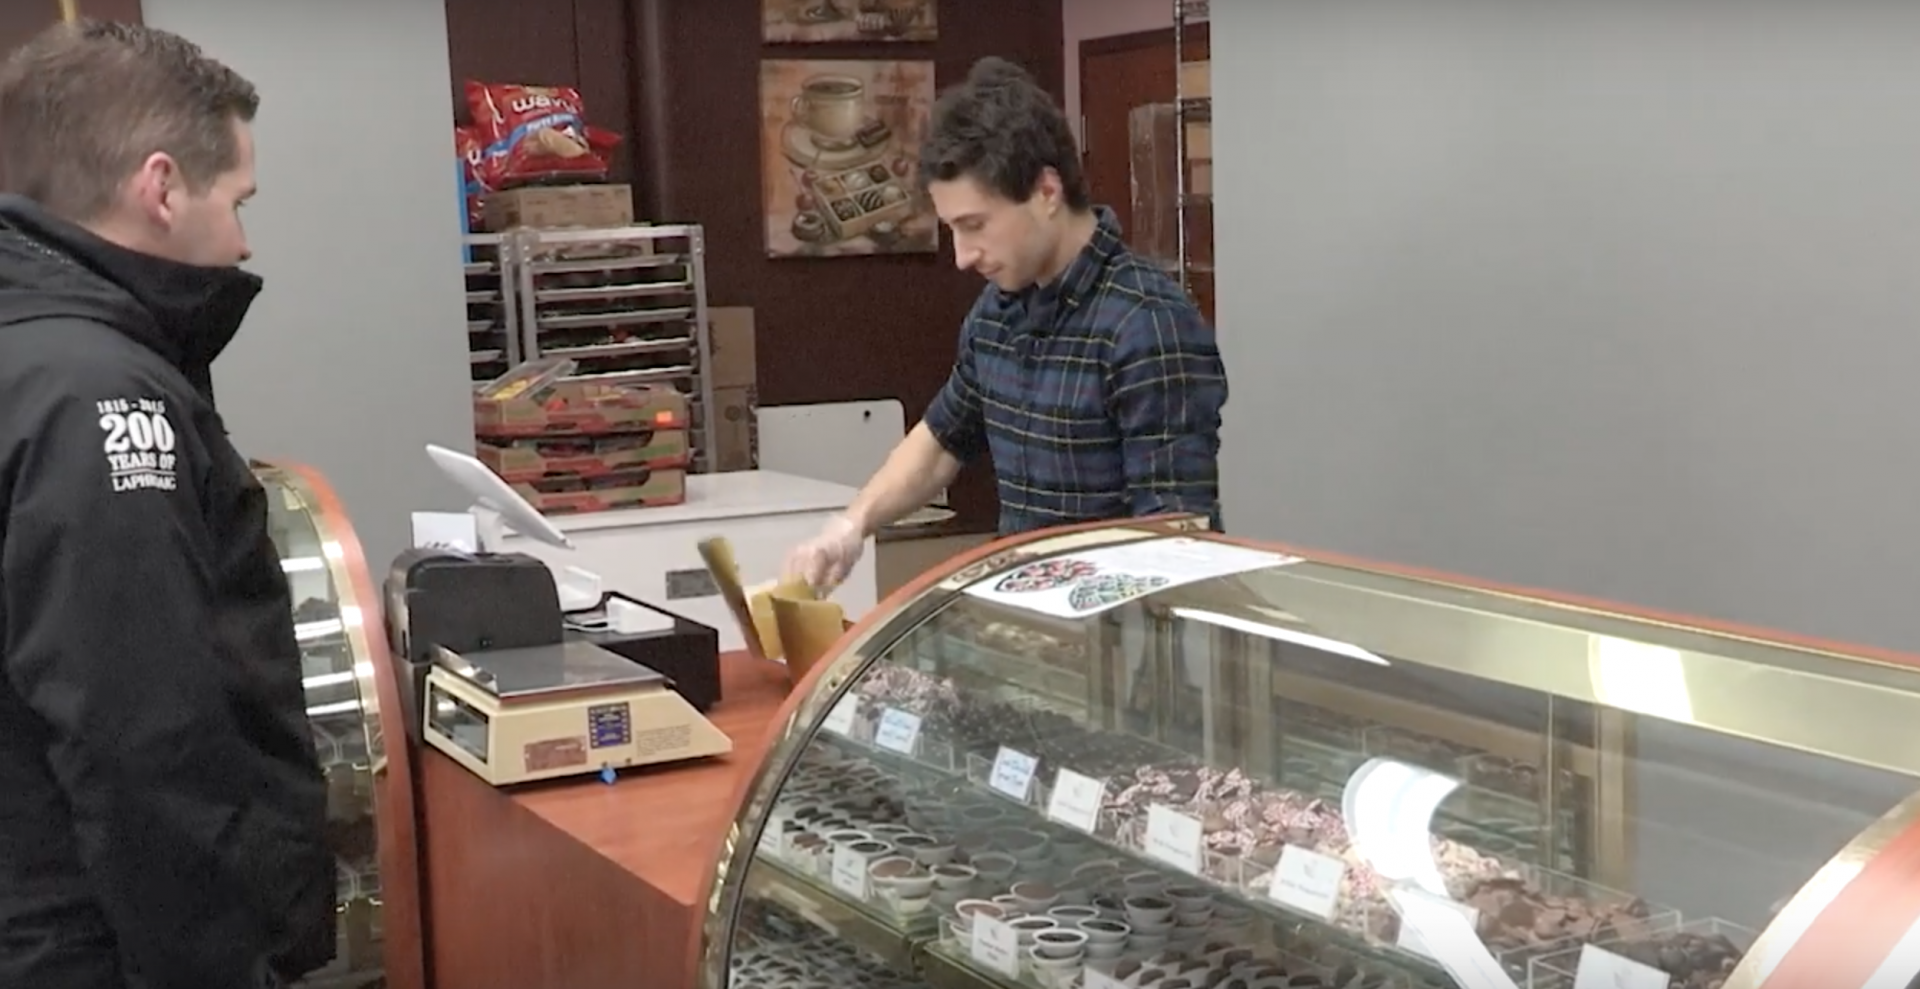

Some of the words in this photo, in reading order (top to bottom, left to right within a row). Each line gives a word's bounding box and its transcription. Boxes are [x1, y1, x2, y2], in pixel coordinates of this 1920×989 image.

[97, 398, 129, 414] 1815
[99, 411, 175, 453] 200
[107, 452, 157, 471] YEARS
[159, 454, 175, 470] OF
